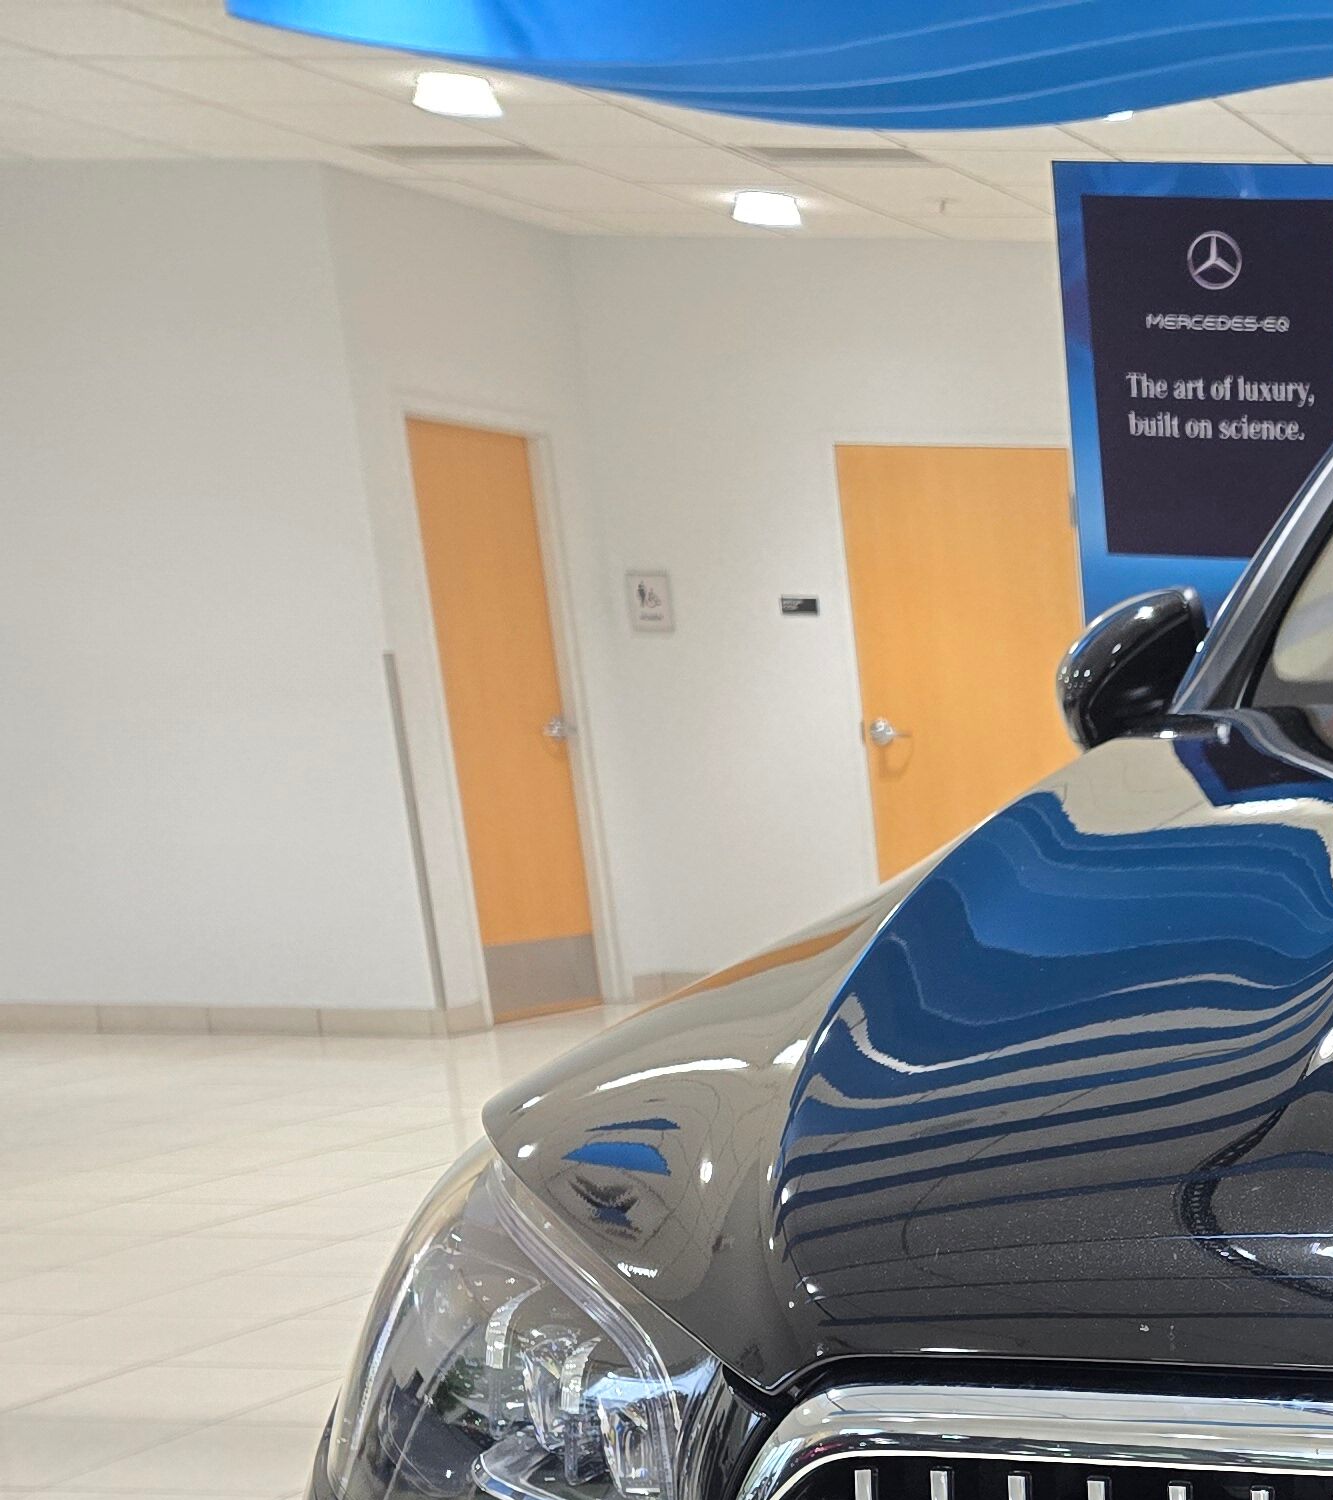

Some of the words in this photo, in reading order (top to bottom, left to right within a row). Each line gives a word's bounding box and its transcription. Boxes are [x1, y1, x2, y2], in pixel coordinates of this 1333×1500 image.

[1146, 313, 1290, 332] MERCEDES-EQ
[1126, 371, 1168, 399] The
[1173, 376, 1206, 400] art
[1210, 374, 1234, 401] of
[1237, 375, 1315, 408] luxury,
[1128, 410, 1180, 438] built
[1185, 417, 1213, 439] on
[1218, 414, 1305, 441] science.
